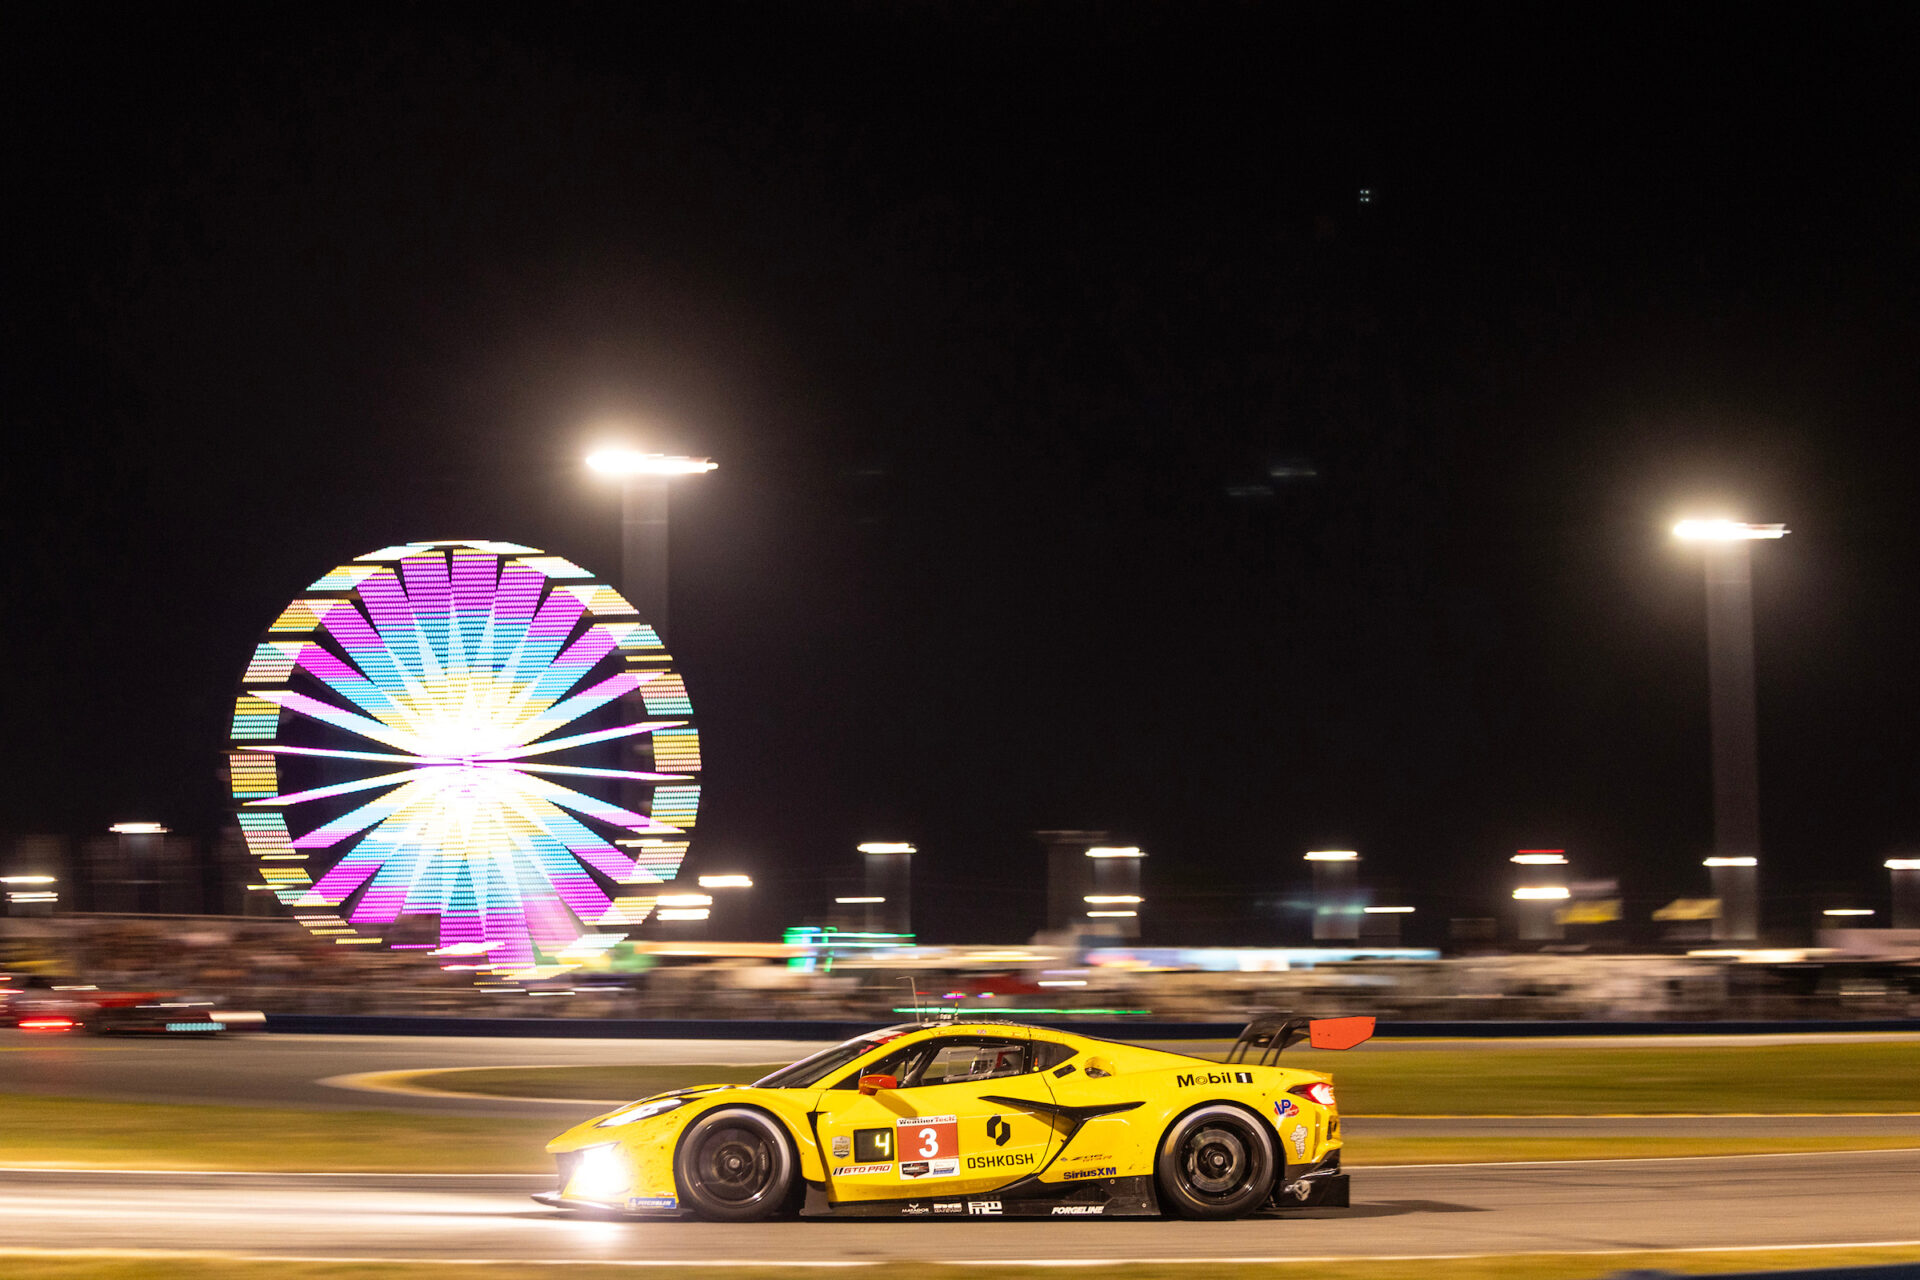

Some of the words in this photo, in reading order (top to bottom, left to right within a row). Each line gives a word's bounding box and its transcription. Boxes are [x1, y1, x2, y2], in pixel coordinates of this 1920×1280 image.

[1177, 1072, 1232, 1087] Mobil
[874, 1132, 890, 1156] 4
[918, 1127, 939, 1158] 3
[967, 1153, 1034, 1169] OSHKOSH
[869, 1165, 891, 1173] PRO
[1063, 1167, 1116, 1180] SiriusXM
[1052, 1206, 1104, 1214] FORGELINE
